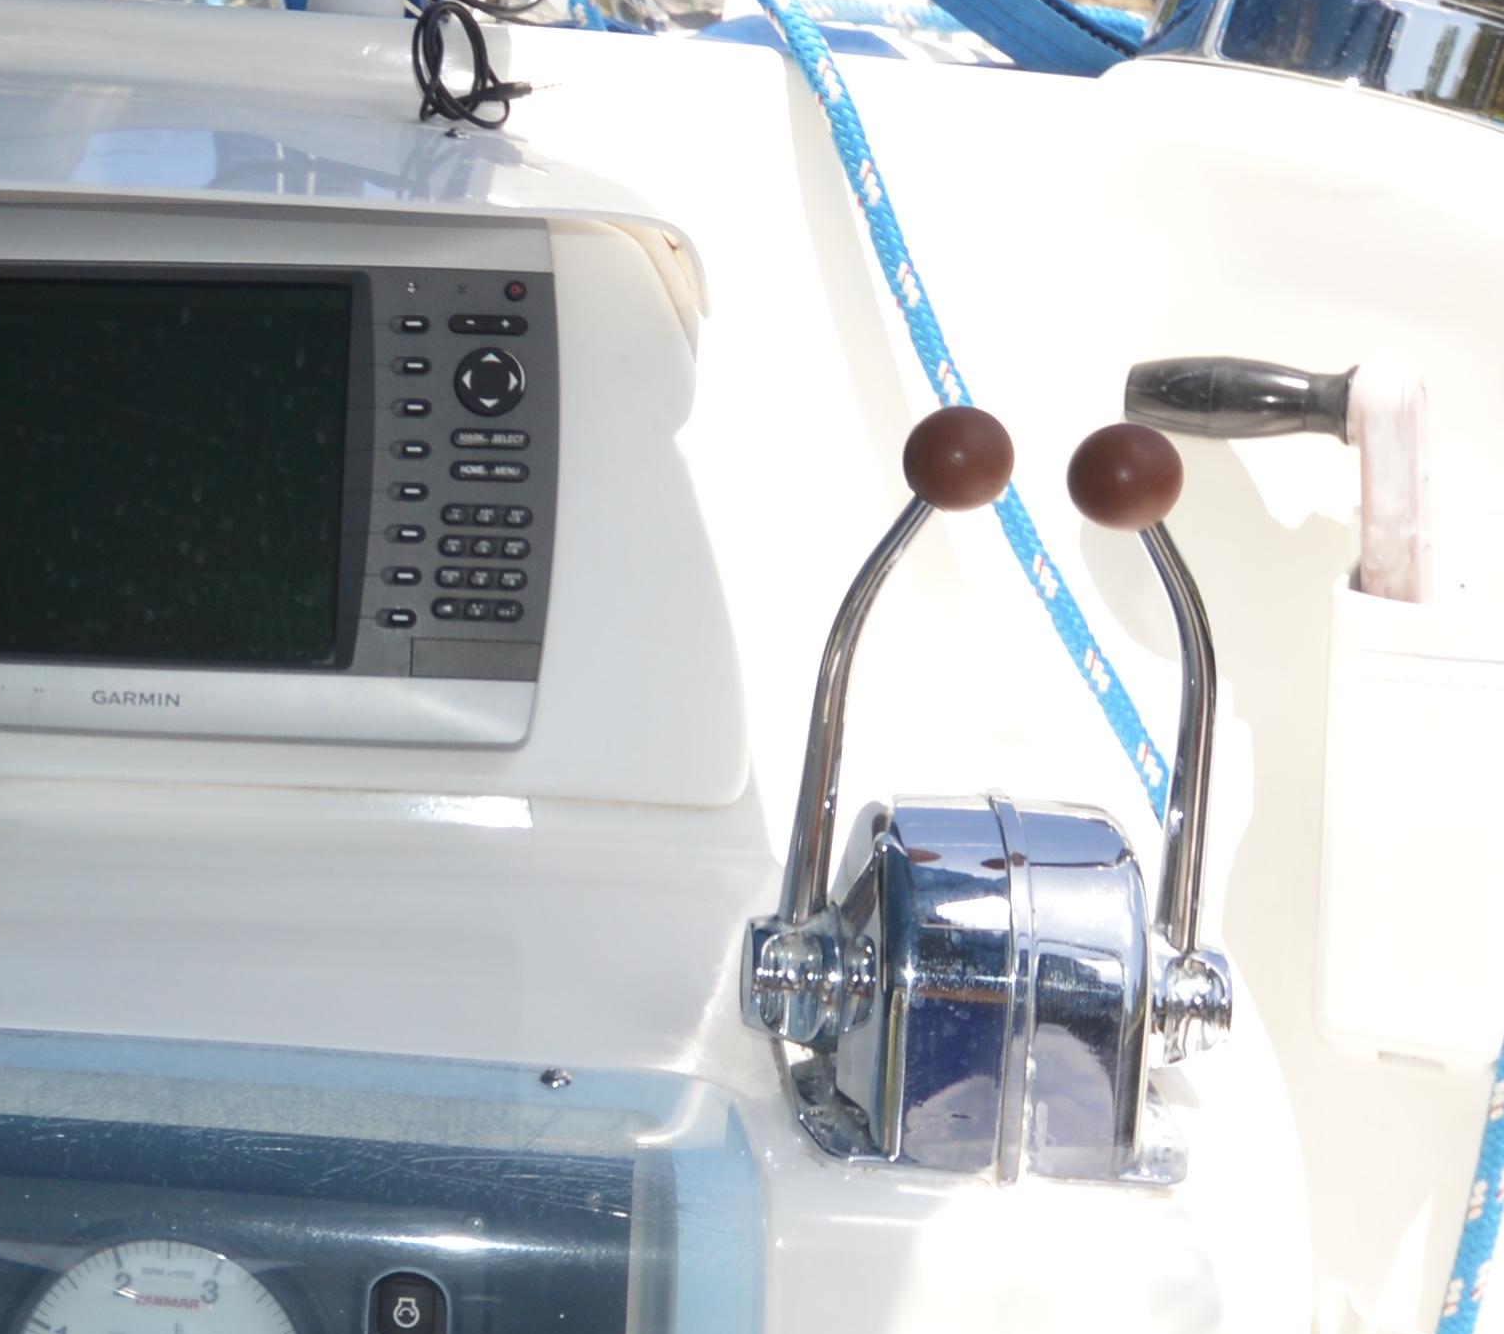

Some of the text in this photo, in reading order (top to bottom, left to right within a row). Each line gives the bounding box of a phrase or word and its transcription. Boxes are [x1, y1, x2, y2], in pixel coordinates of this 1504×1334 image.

[492, 433, 525, 444] SELECT
[459, 465, 485, 475] HOME
[494, 466, 521, 476] MENU
[91, 689, 181, 708] GARMIN
[113, 1271, 133, 1297] 2
[201, 1279, 220, 1305] 3
